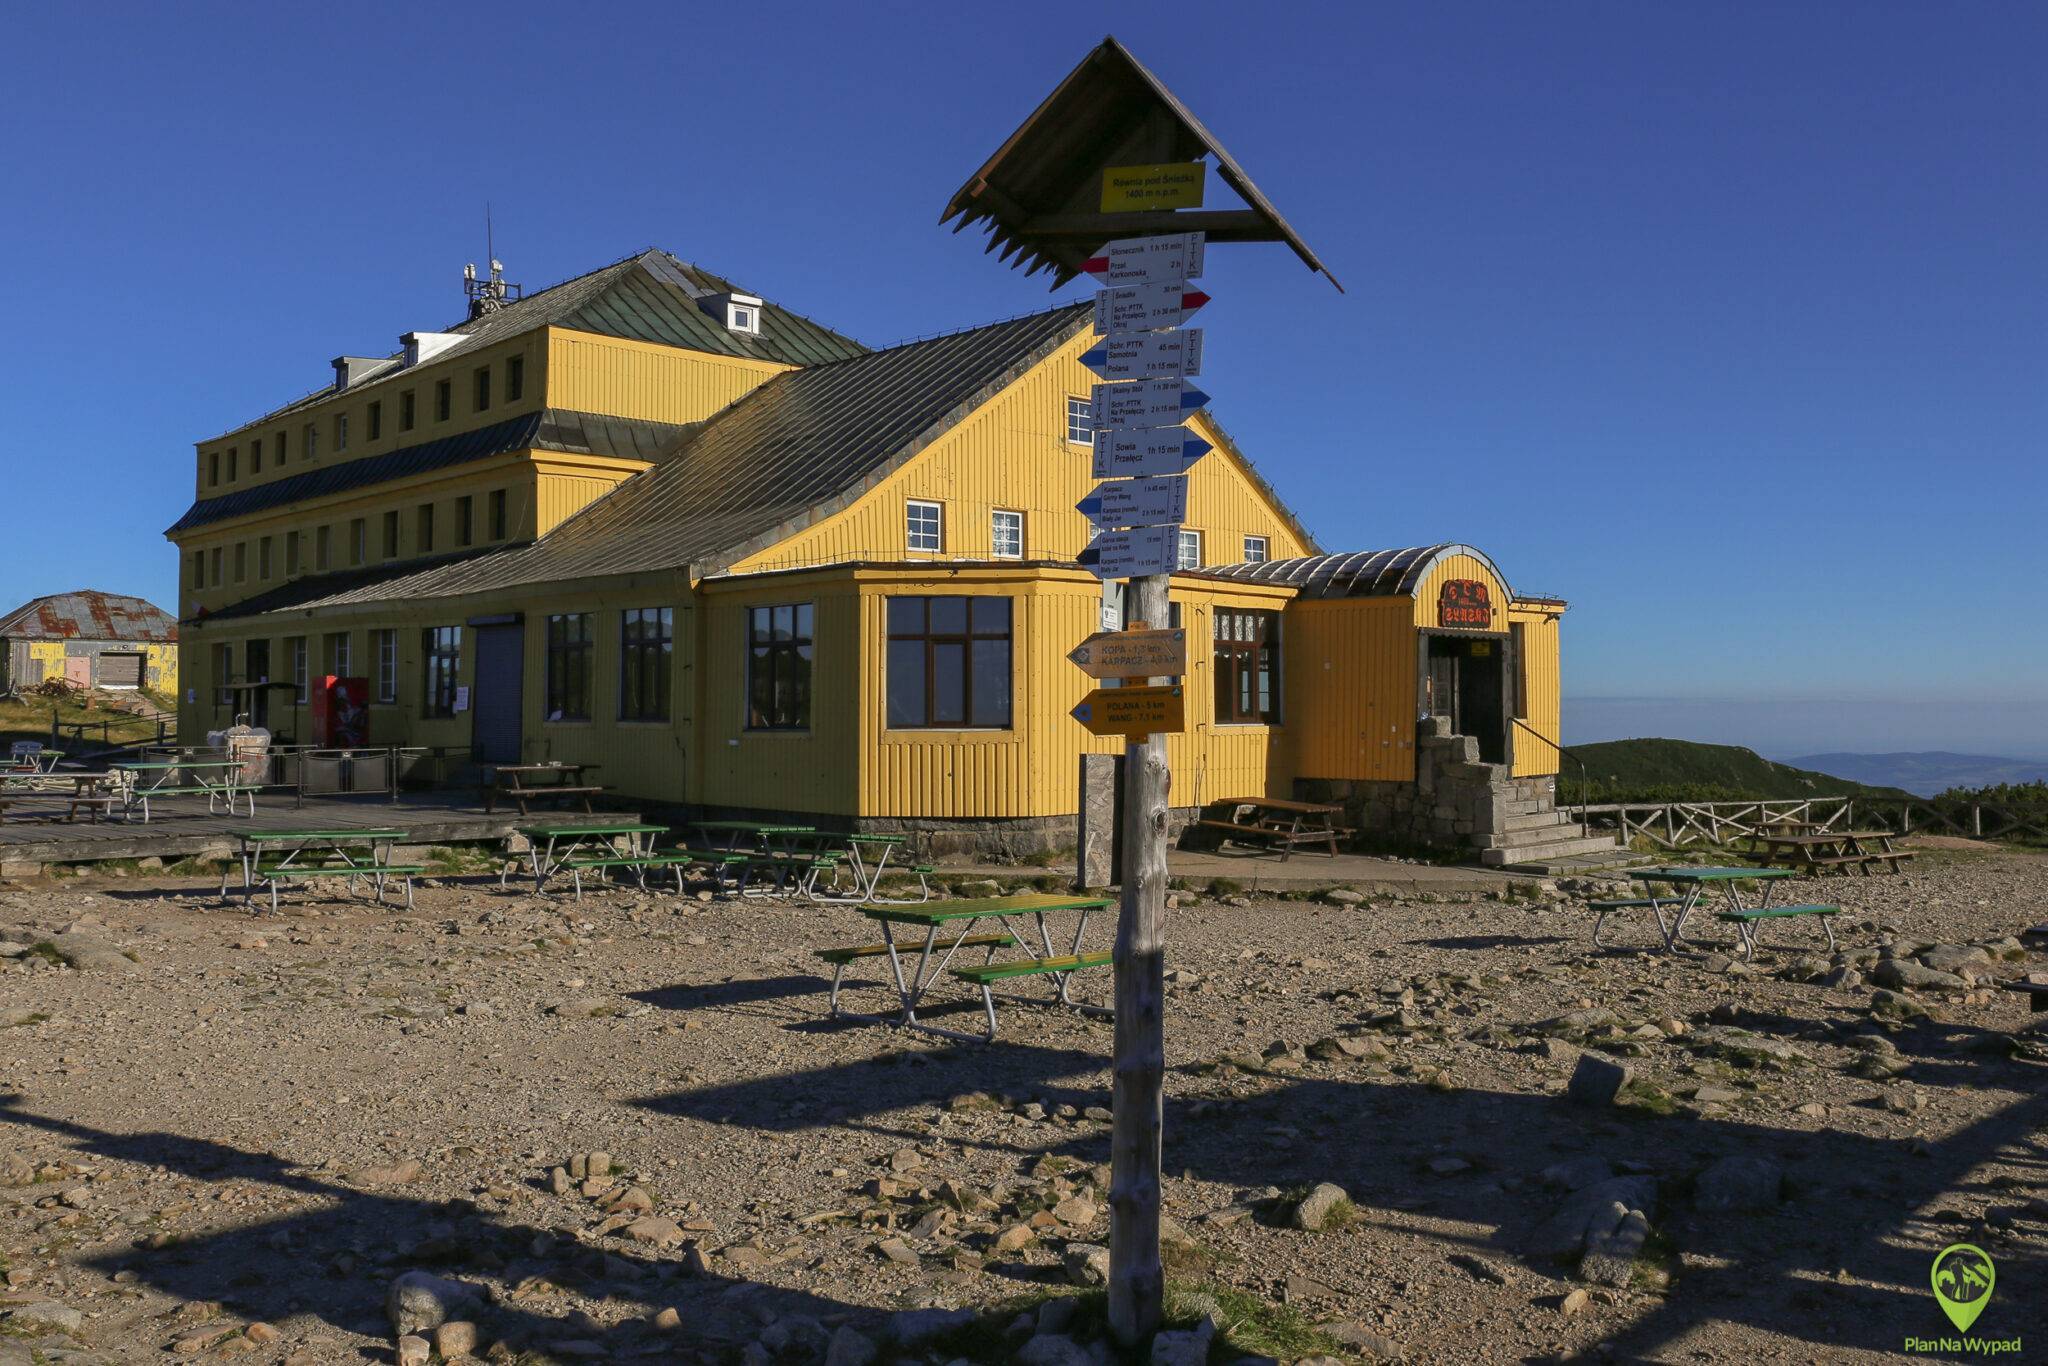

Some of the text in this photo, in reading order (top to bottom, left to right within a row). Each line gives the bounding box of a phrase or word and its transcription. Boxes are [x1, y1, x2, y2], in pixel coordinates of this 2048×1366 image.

[1144, 176, 1161, 186] pod
[1189, 234, 1198, 270] PTTK
[1100, 290, 1108, 325] PTTK
[1188, 330, 1196, 366] PTTK
[1174, 477, 1182, 514] PTTK
[1103, 646, 1126, 654] KOPA
[1102, 656, 1142, 665] KARPACZ
[1107, 702, 1140, 711] POLANA
[1108, 714, 1132, 722] WANG
